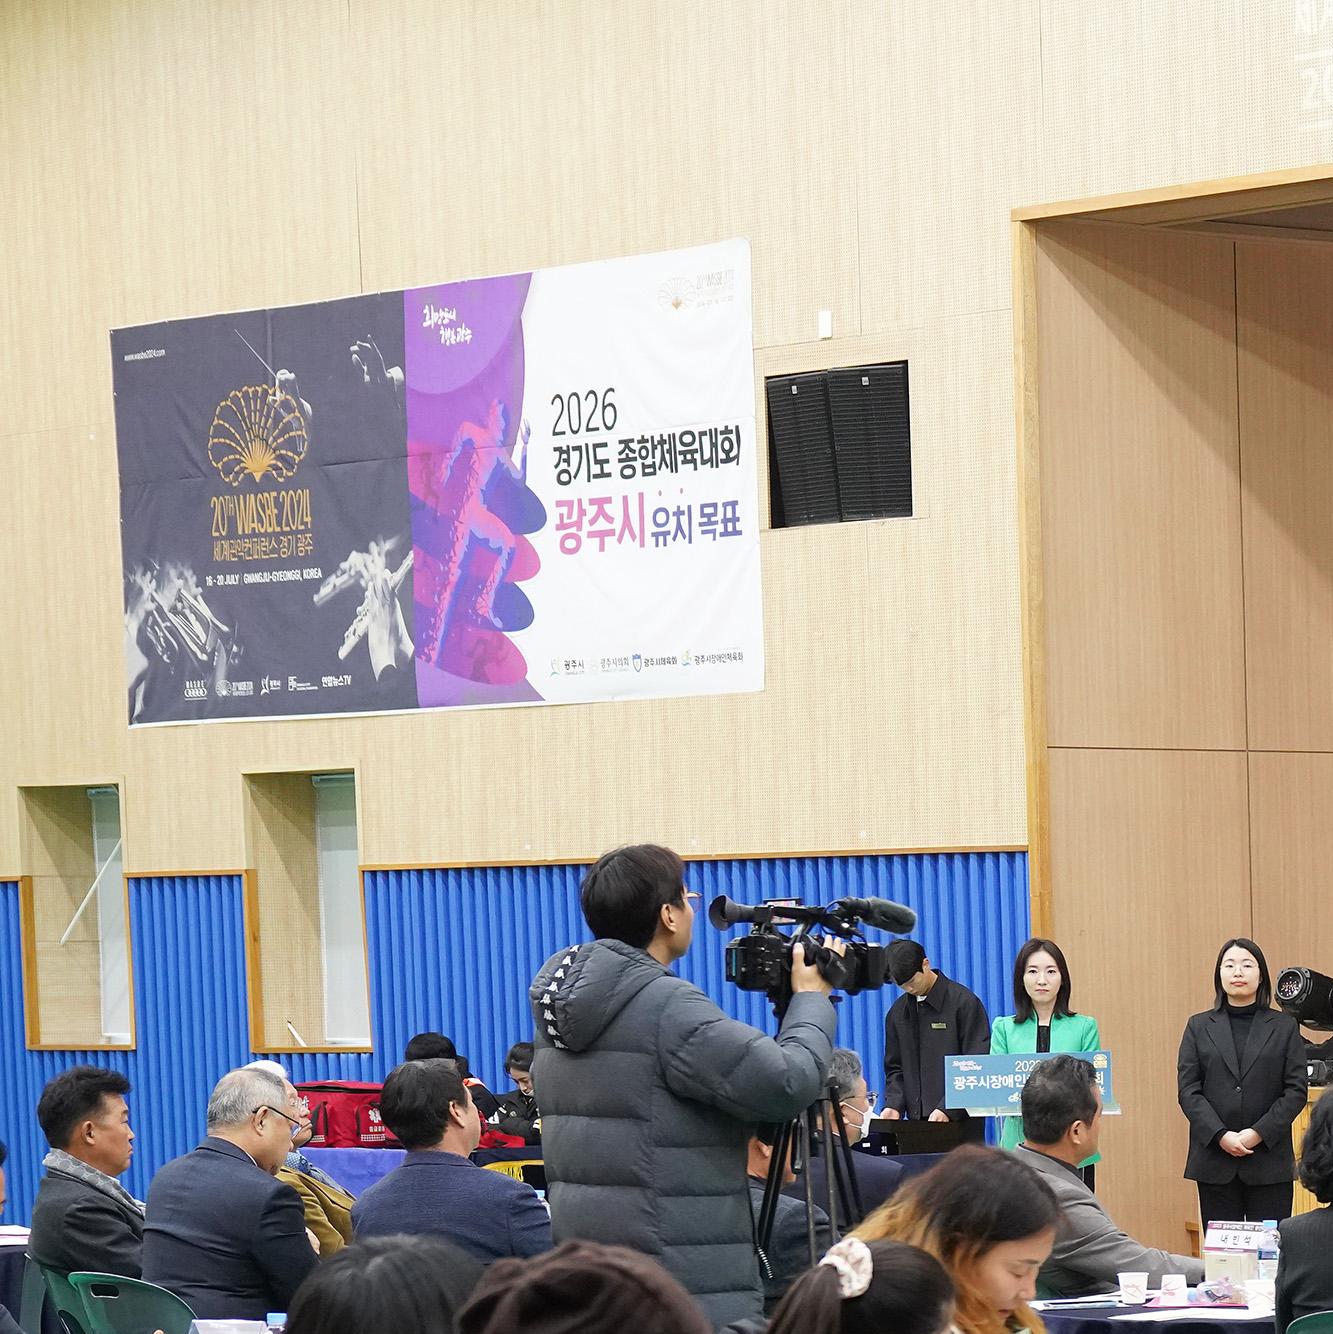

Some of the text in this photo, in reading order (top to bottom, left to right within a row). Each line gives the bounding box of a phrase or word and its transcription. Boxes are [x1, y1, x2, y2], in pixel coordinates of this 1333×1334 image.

[550, 387, 618, 437] 2026
[553, 424, 741, 486] 경기도 종합체육대회
[234, 491, 281, 536] WASBE
[279, 488, 312, 532] 2024
[555, 491, 743, 555] 광주시 유치 목표
[280, 534, 297, 558] 경기
[297, 533, 314, 557] 광주
[302, 567, 323, 580] KOREA
[953, 1073, 1029, 1090] 광주시장애인
